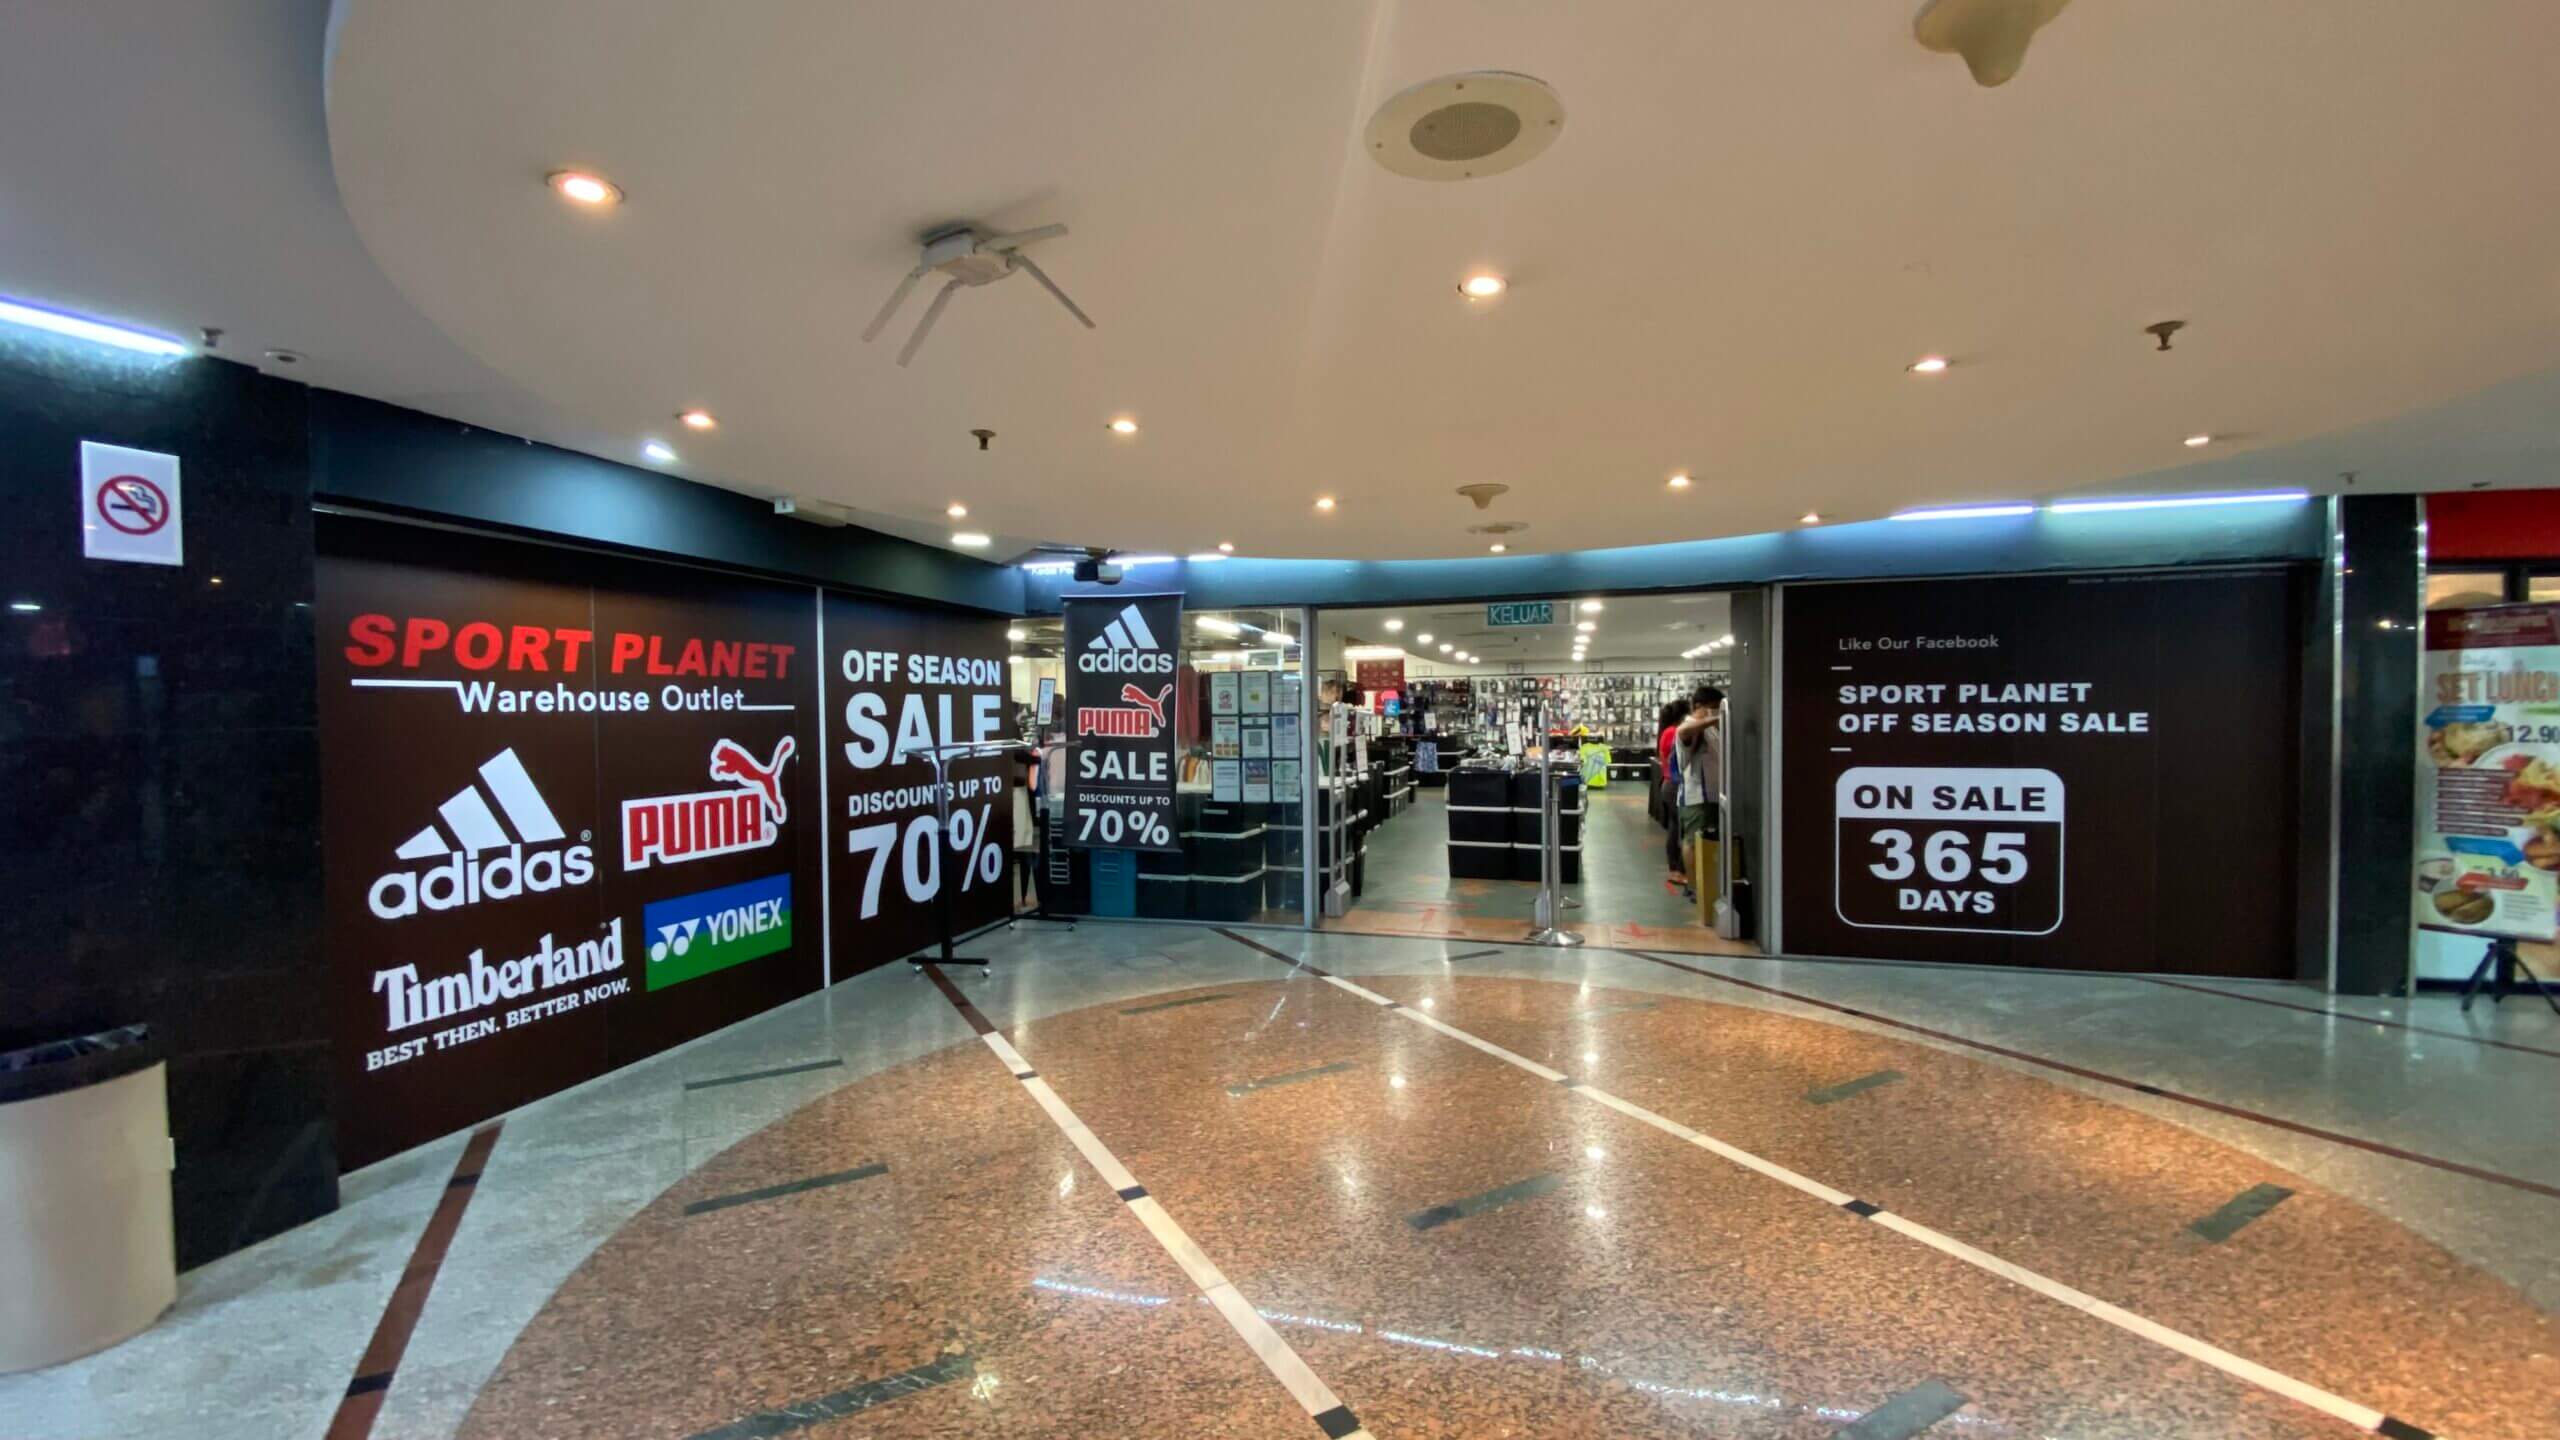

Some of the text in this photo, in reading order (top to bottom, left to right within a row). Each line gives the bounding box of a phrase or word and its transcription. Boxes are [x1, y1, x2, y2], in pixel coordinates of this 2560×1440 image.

[1490, 604, 1553, 624] KELUAR
[344, 613, 795, 679] SPORT PLANET
[1838, 633, 2000, 651] Like Our Facebook
[842, 649, 1001, 687] OFF SEASON
[1078, 647, 1173, 674] adidas
[457, 680, 744, 714] Warehouse Outlet
[1838, 682, 2093, 705] SPORT PLANET
[2436, 672, 2482, 702] SET
[844, 691, 1003, 771] SALE
[1078, 707, 1152, 738] PUMA
[1838, 711, 2150, 734] OFF SEASON SALE
[1079, 749, 1168, 782] SALE
[959, 779, 979, 799] UP
[983, 776, 1003, 795] TO
[1079, 792, 1171, 806] DISCOUNTS UP TO
[1853, 785, 2047, 813] ON SALE
[626, 790, 766, 866] PUMA
[1078, 808, 1170, 846] 70%
[849, 803, 1004, 921] 70%
[1868, 828, 2029, 885] 365
[368, 842, 595, 920] adidas
[1898, 888, 1995, 914] DAYS
[705, 897, 785, 946] YONEX
[372, 916, 625, 1033] Timberland
[365, 977, 631, 1072] BEST THEN. BETTER NOW.
